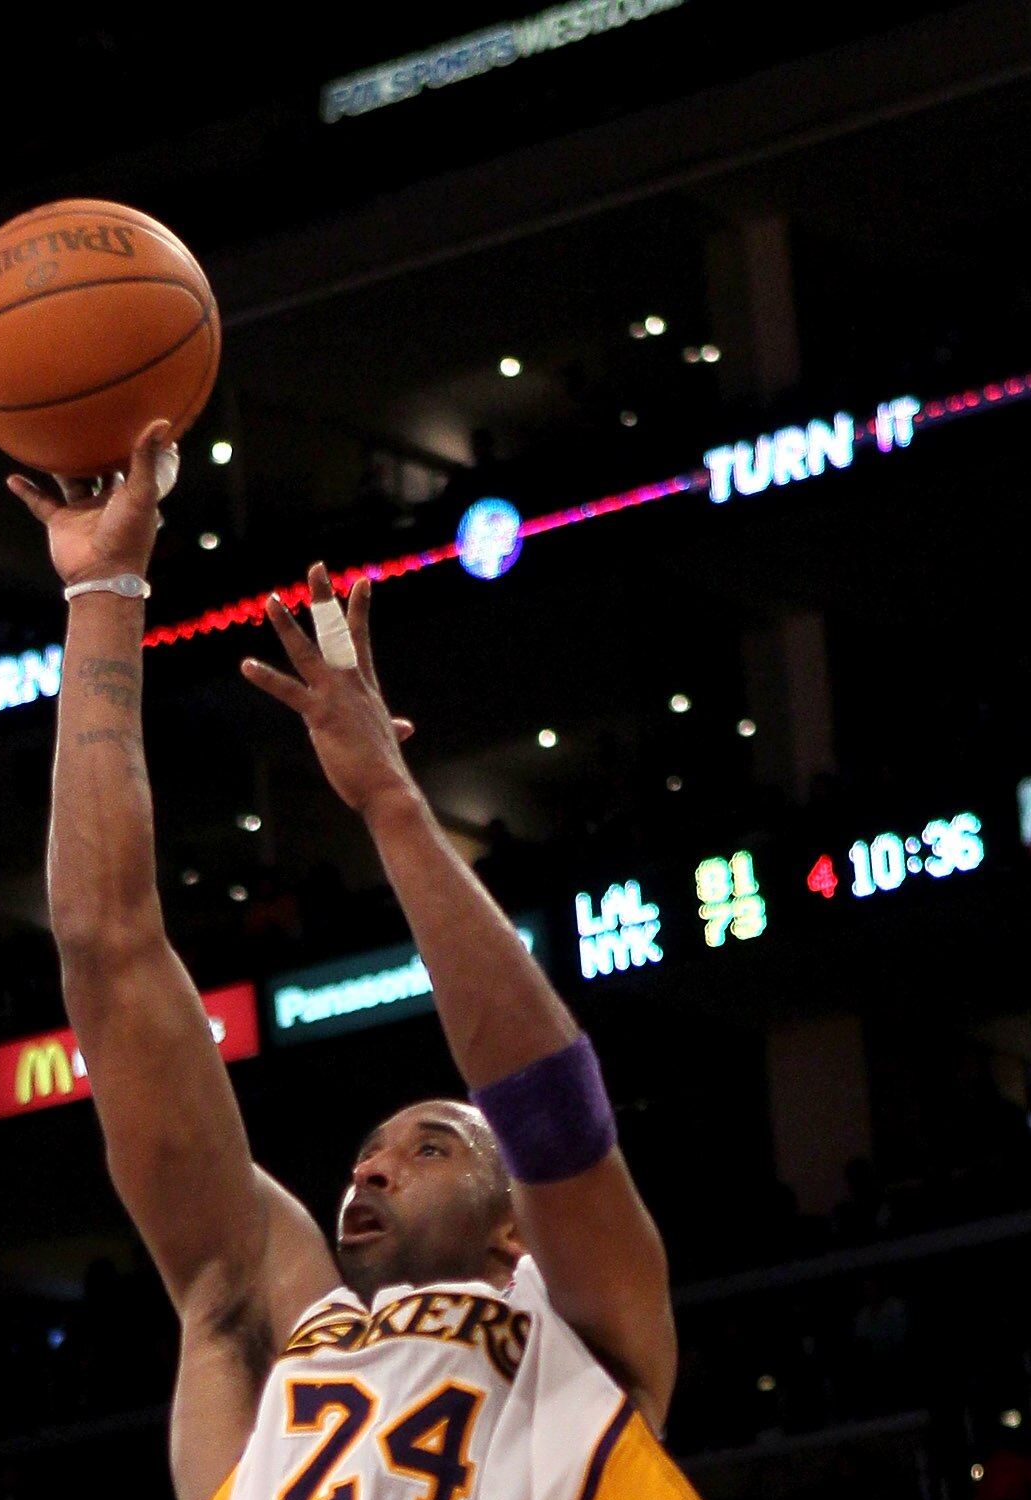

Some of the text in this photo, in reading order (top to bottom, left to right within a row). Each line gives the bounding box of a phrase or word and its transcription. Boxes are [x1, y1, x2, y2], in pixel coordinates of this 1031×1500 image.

[703, 395, 921, 503] TURN IT
[808, 854, 838, 899] 4
[849, 812, 984, 897] 10:36
[575, 879, 660, 937] LAL
[579, 919, 664, 979] NYK
[275, 953, 434, 1028] Panasoni
